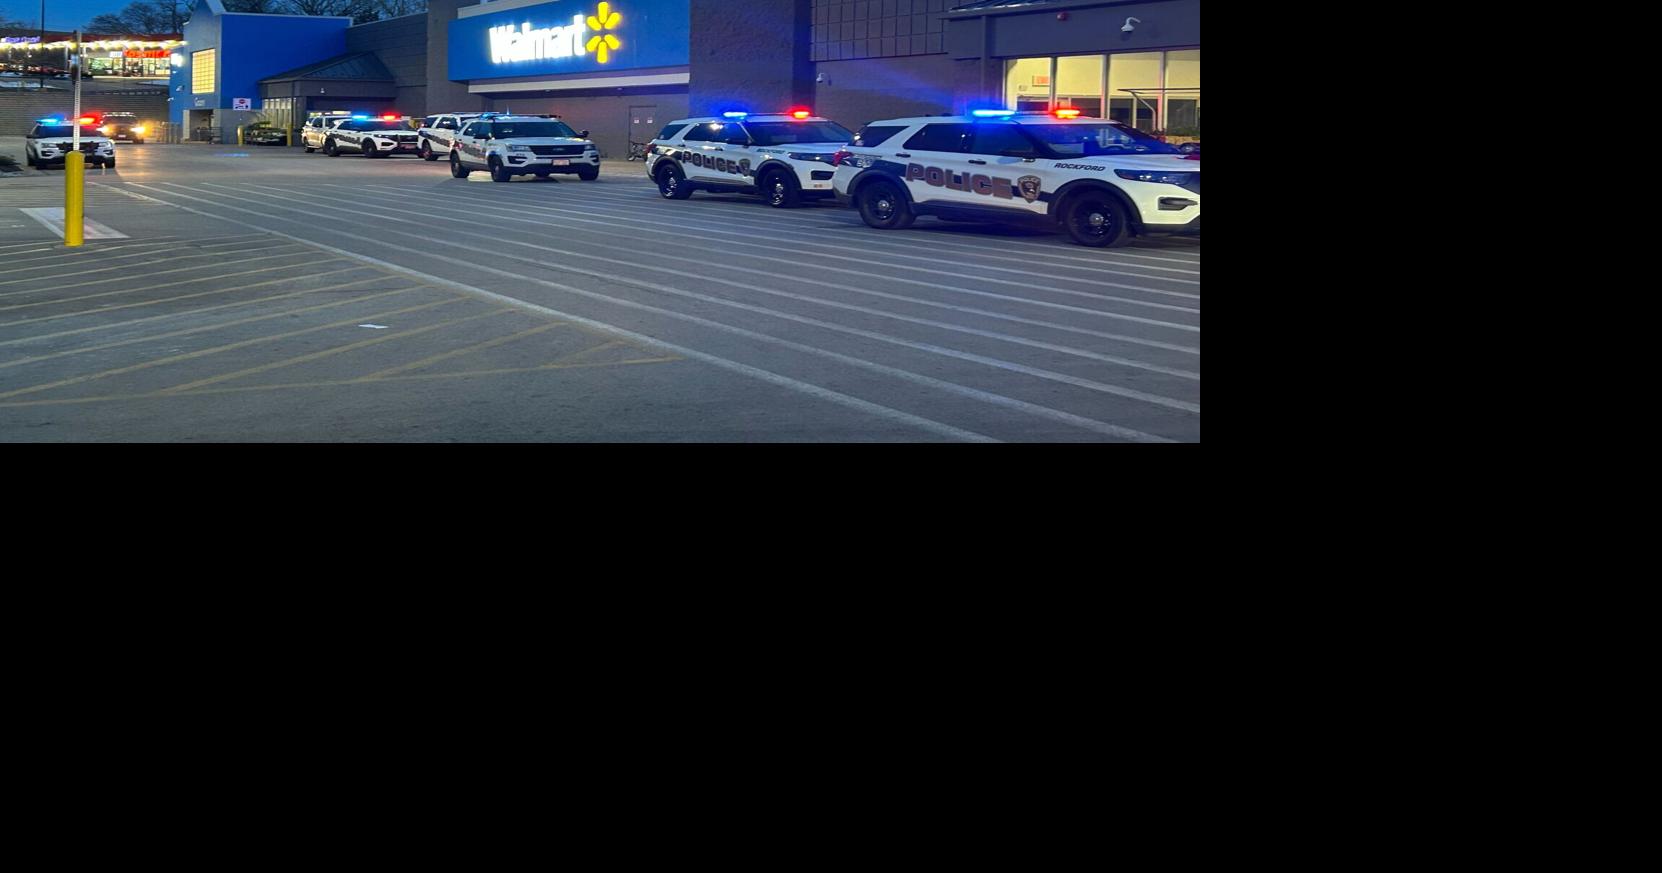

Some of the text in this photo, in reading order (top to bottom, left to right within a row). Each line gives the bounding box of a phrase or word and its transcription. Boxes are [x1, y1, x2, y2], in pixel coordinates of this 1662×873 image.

[489, 14, 585, 63] Walmart
[682, 150, 737, 175] POLICE
[1054, 162, 1106, 172] ROCKFORD
[906, 162, 1013, 200] POLICE
